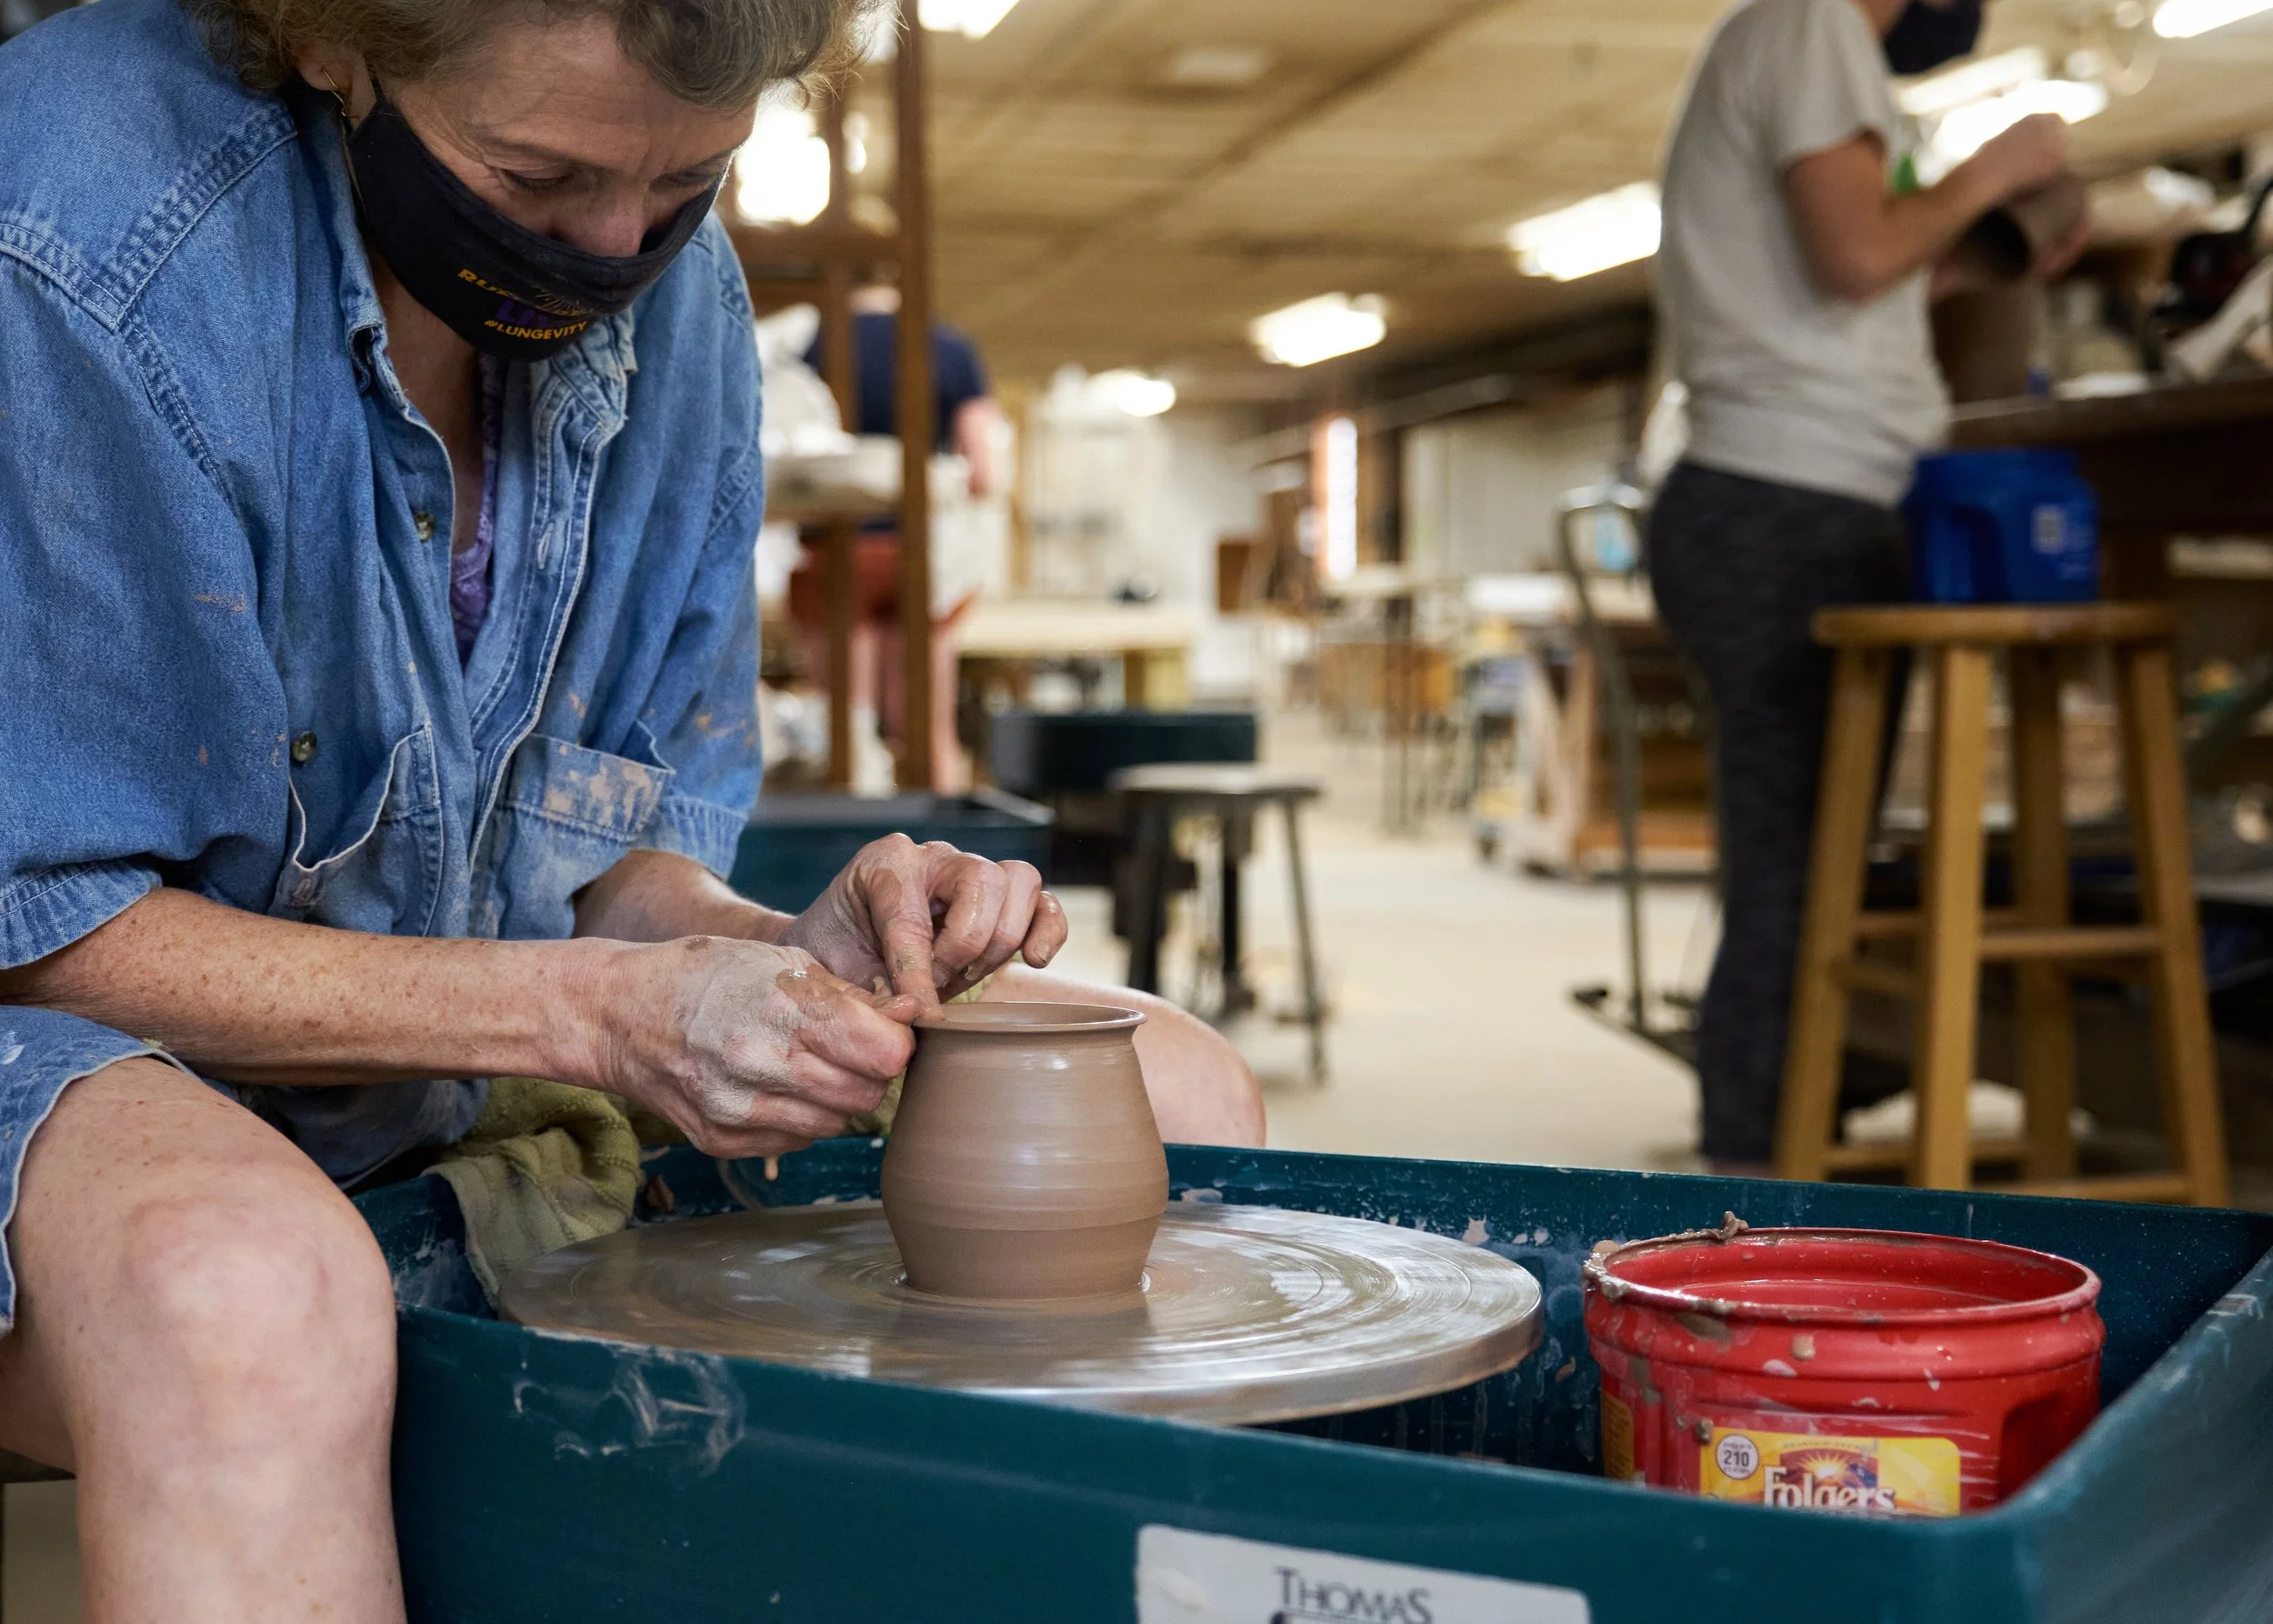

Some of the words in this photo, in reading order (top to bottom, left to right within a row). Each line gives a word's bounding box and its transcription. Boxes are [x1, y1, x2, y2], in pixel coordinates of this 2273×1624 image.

[484, 319, 587, 340] #LUNGEVITY
[1724, 1449, 1749, 1467] 210
[1764, 1466, 1896, 1509] Folgers
[1275, 1566, 1433, 1624] THOMAS
